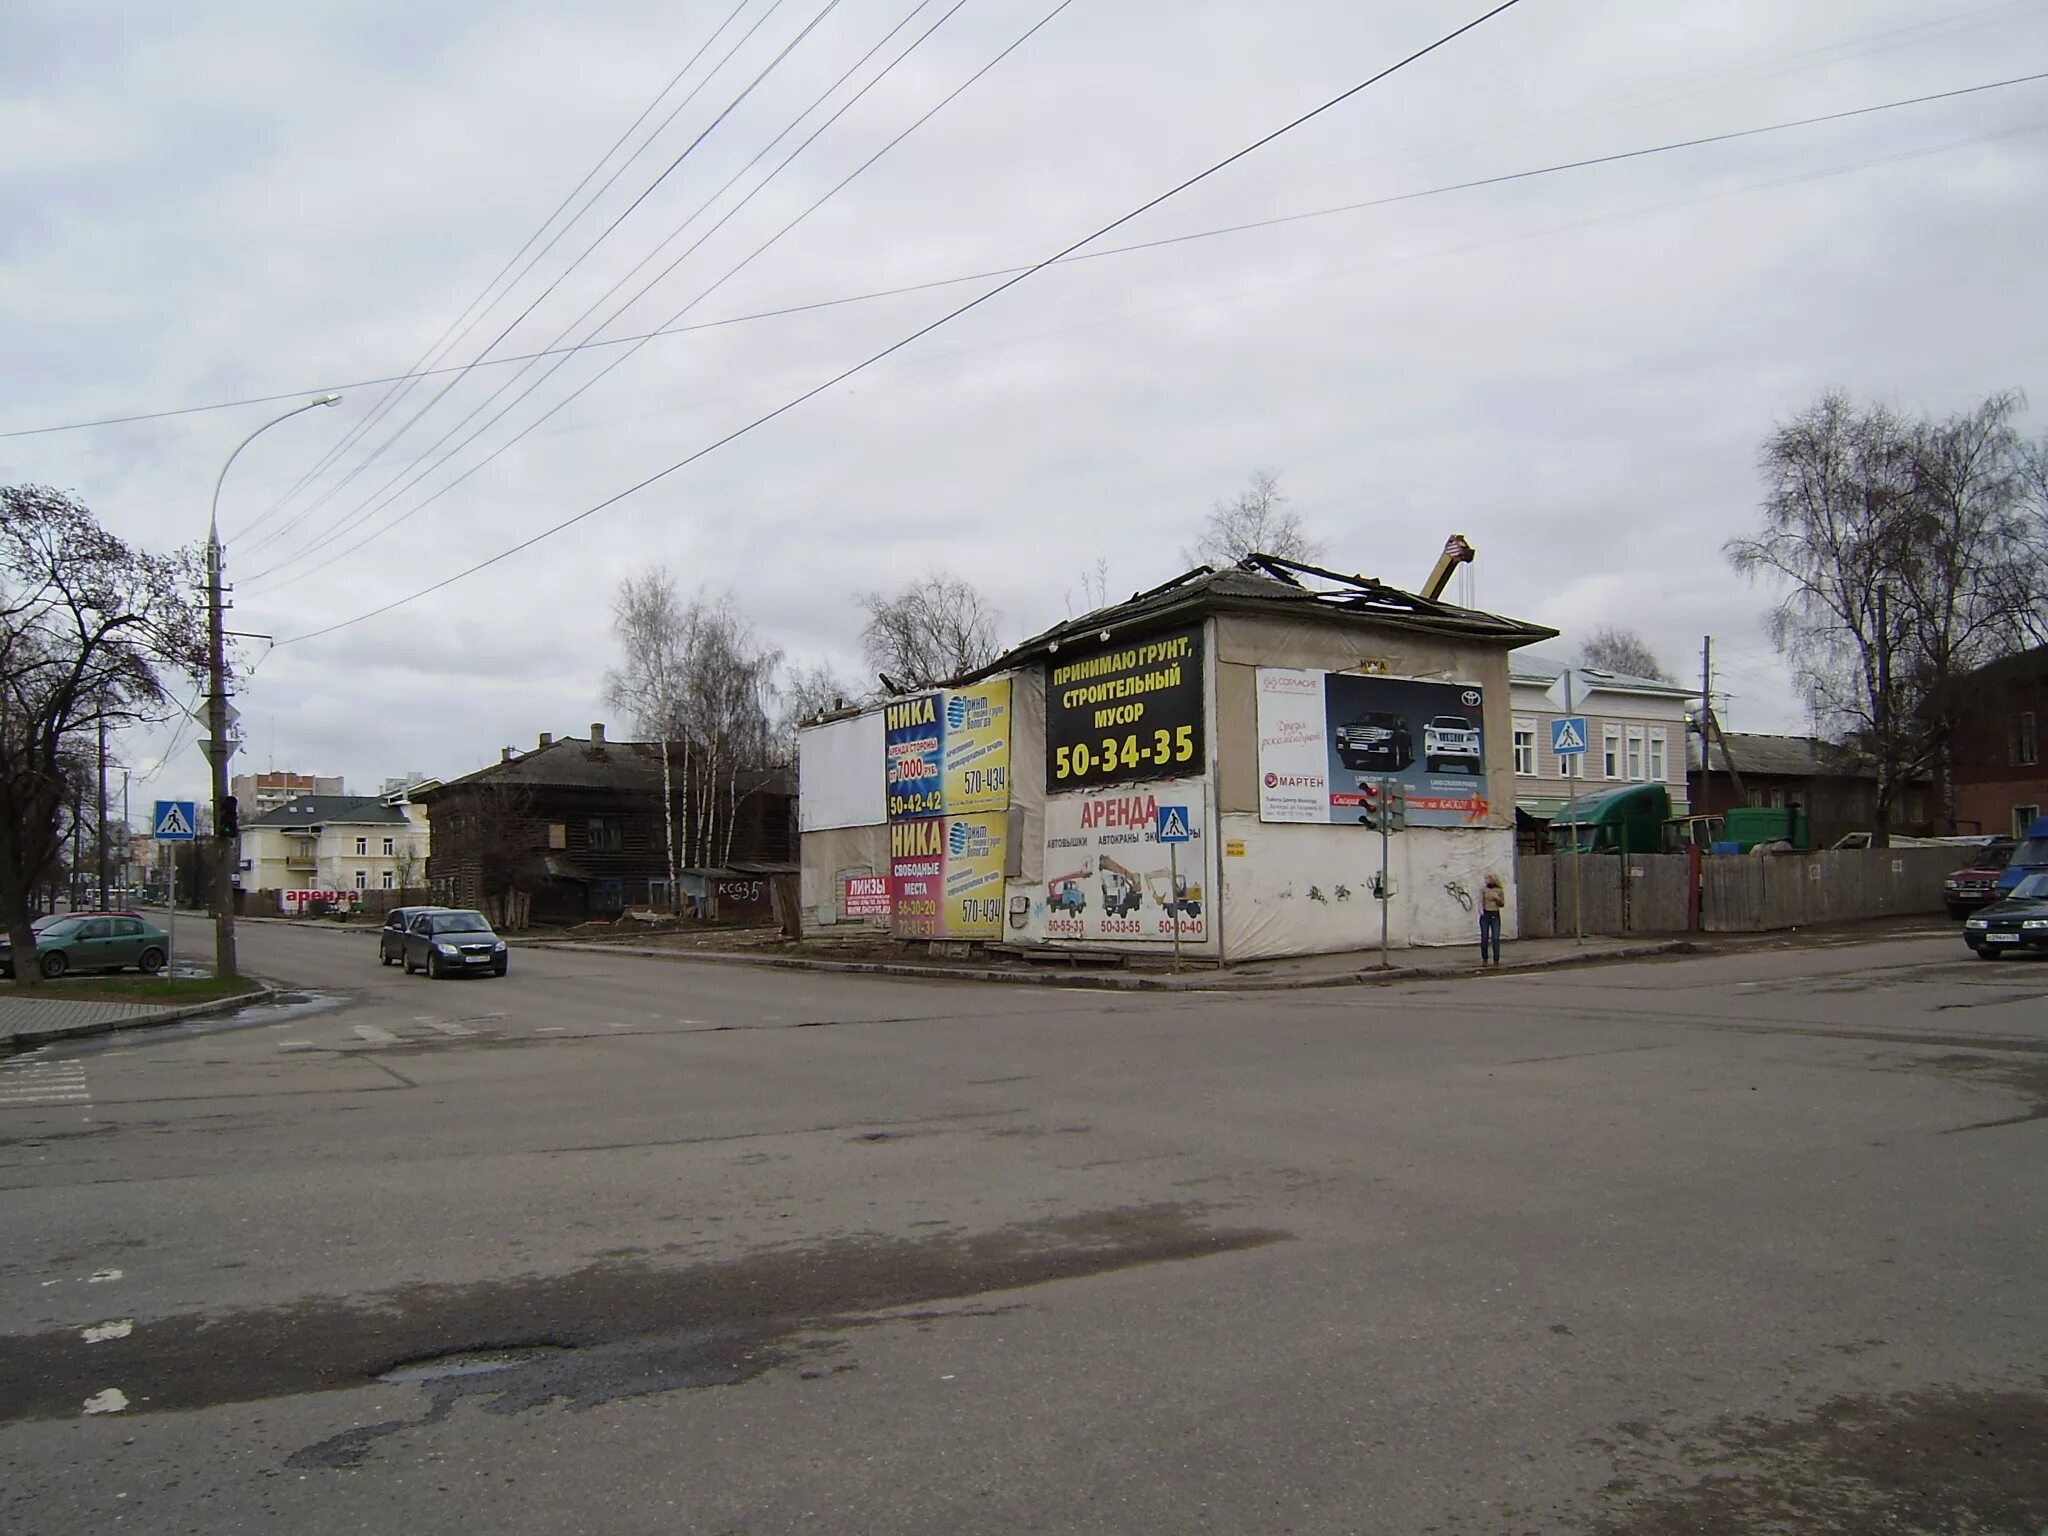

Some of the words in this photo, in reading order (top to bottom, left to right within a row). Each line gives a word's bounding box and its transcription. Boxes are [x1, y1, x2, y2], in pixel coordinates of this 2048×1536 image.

[1053, 650, 1136, 686] ПРИНИМАЮ
[1138, 636, 1193, 666] ГРУНТ,
[1062, 662, 1181, 709] СТРОИТЕЛЬНЫЙ
[887, 699, 936, 731] НИКА
[1094, 703, 1144, 729] МУСОР
[889, 745, 909, 756] АРЕНДА
[910, 740, 937, 753] СТОРОНЫ
[1056, 725, 1194, 779] 50-34-35
[897, 757, 923, 780] 7000
[964, 766, 1005, 795] 570-434
[1279, 776, 1324, 788] МАРТЕН
[890, 791, 942, 815] 50-42-42
[1081, 795, 1158, 830] АРЕНДА
[891, 820, 941, 857] НИКА
[1047, 836, 1088, 849] АВТОВЫШКИ
[1098, 833, 1139, 846] АВТОКРАНЫ
[894, 862, 940, 877] СВОБОДНЫЕ
[850, 878, 886, 896] ЛИНЗЫ
[904, 882, 928, 896] МЕСТА
[898, 900, 936, 916] 56-30-20
[962, 899, 1000, 923] 570-434
[1048, 920, 1084, 932] 50-55-33
[1101, 920, 1141, 932] 50-33-55
[1158, 920, 1203, 933] 50-0-40
